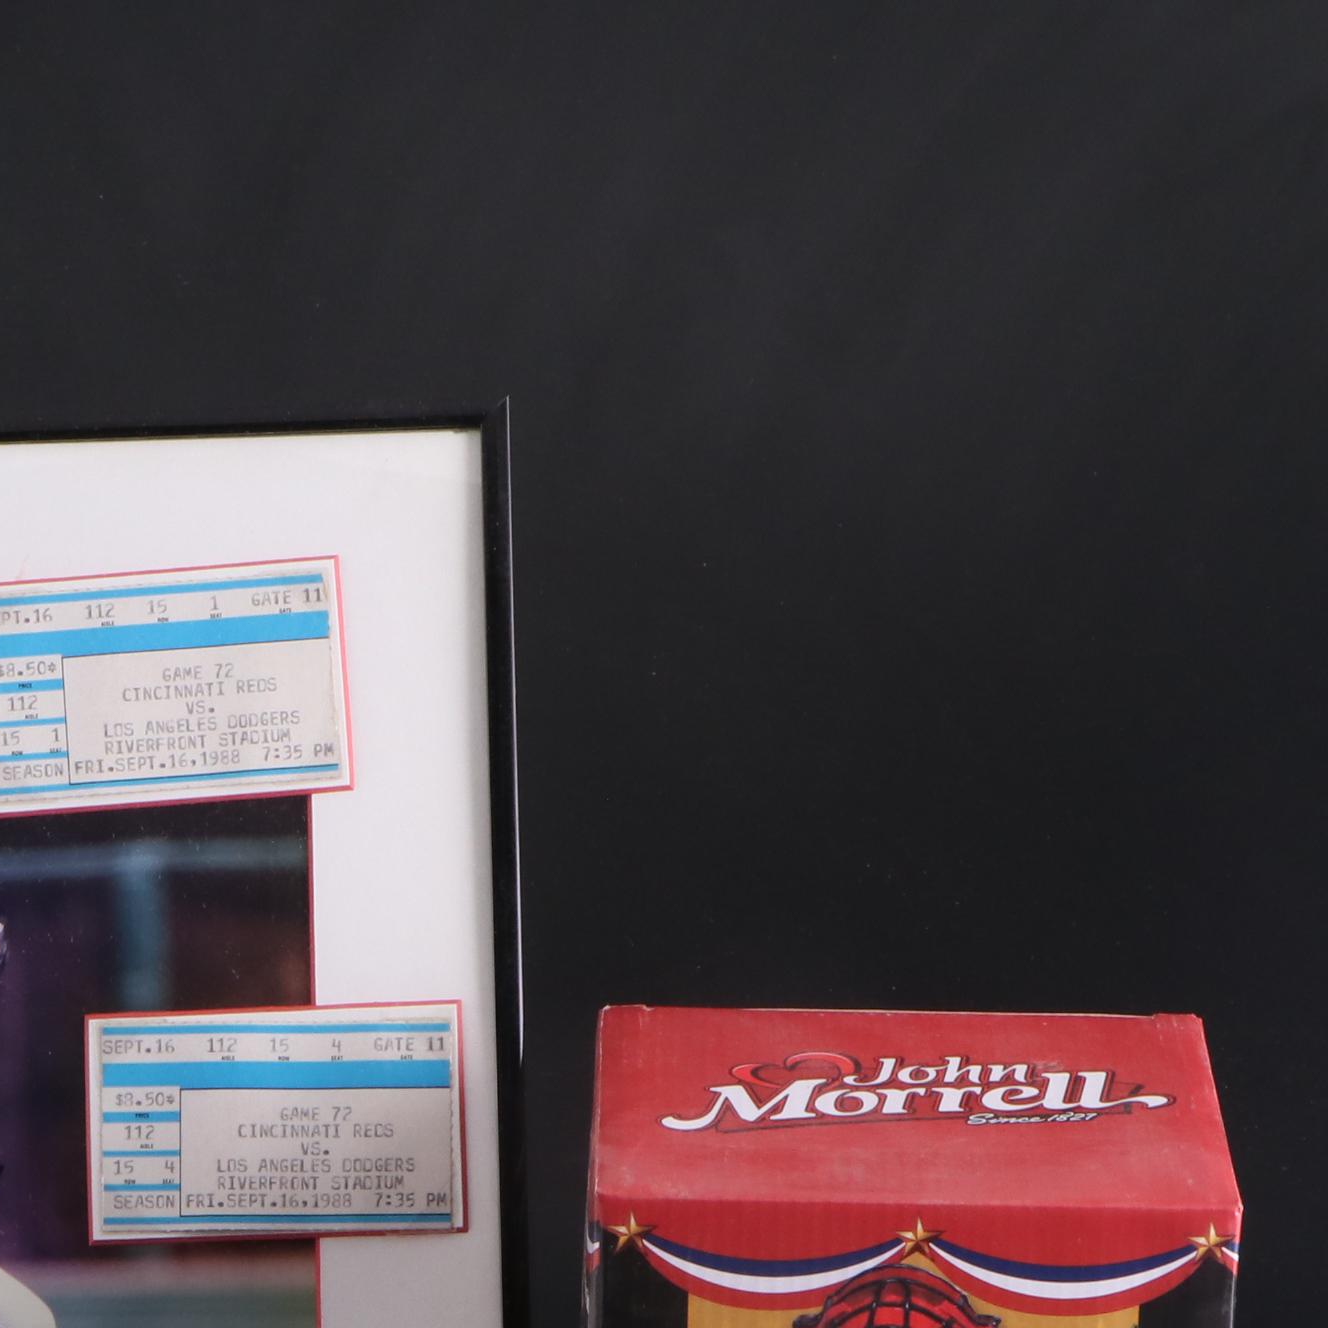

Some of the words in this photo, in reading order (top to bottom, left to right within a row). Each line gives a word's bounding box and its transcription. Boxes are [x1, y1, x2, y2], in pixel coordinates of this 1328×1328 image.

[85, 603, 115, 620] 112
[147, 599, 168, 615] 15
[211, 595, 220, 611] 1
[251, 589, 292, 607] GATE
[303, 587, 323, 603] 11
[162, 666, 202, 682] GAME
[215, 663, 234, 679] 72
[122, 681, 225, 702] CINCINNATI
[236, 677, 278, 694] REDS
[8, 695, 38, 711] 112
[186, 701, 215, 715] VS.
[103, 722, 134, 738] LOS
[145, 716, 217, 735] ANGELES
[227, 710, 301, 729] DODGERS
[1, 731, 20, 746] 15
[52, 727, 60, 743] 1
[105, 734, 206, 755] RIVERFRONT
[219, 728, 291, 746] STADIUM
[262, 744, 303, 762] 7:35
[313, 743, 335, 757] PM
[2, 763, 64, 781] SEASON
[102, 1038, 175, 1054] SEPT.16
[207, 1037, 238, 1053] 112
[270, 1038, 289, 1052] 15
[332, 1038, 342, 1053] 4
[374, 1037, 415, 1052] GATE
[427, 1036, 445, 1051] 11
[844, 1056, 1030, 1086] John
[660, 1071, 1170, 1131] Morrell
[280, 1106, 320, 1122] GAME
[331, 1106, 352, 1121] 72
[124, 1125, 155, 1140] 112
[237, 1123, 341, 1139] CINCINNATI
[301, 1141, 330, 1156] VS.
[113, 1160, 134, 1175] 15
[164, 1159, 175, 1174] 4
[217, 1158, 248, 1173] LOS
[258, 1158, 331, 1173] ANGELES
[342, 1157, 416, 1173] DODGERS
[217, 1175, 319, 1190] RIVERFRONT
[330, 1175, 405, 1190] STADIUM
[113, 1194, 175, 1210] SEASON
[374, 1192, 416, 1208] 7:35
[426, 1192, 448, 1207] PM
